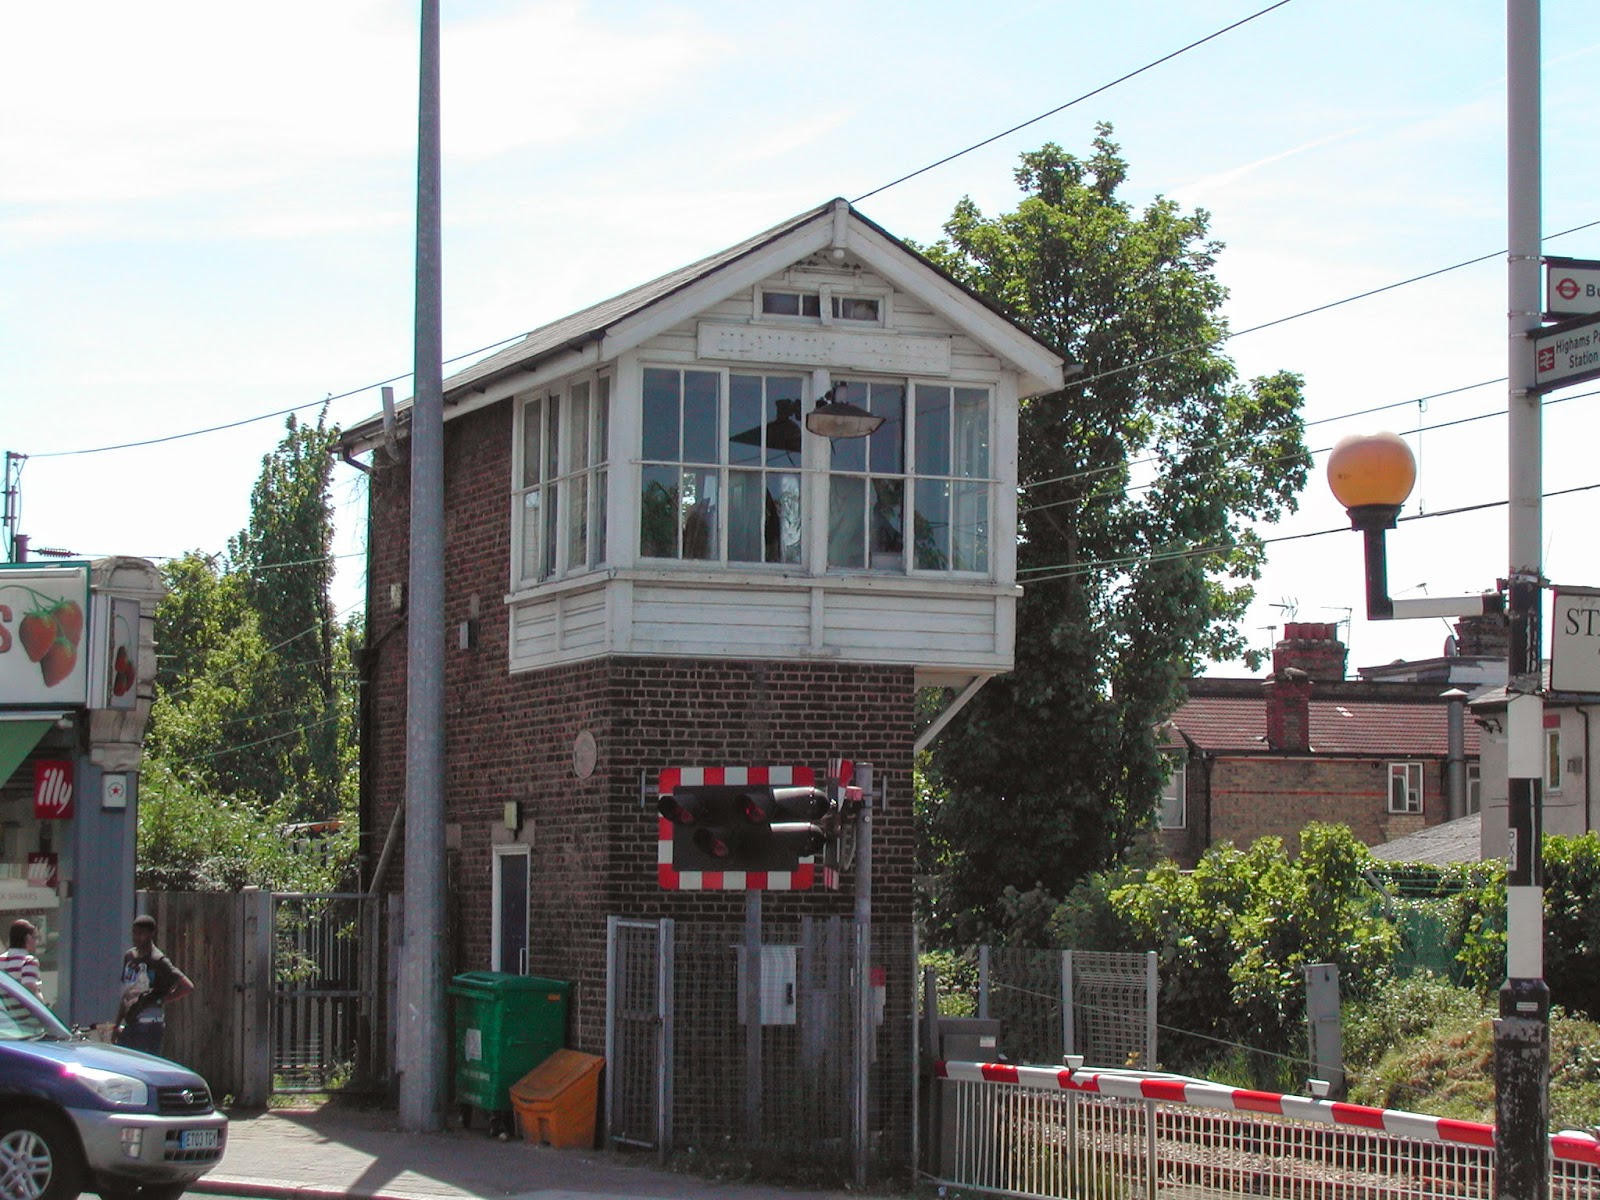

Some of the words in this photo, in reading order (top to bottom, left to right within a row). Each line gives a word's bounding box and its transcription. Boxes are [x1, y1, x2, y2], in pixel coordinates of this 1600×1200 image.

[1556, 335, 1590, 354] Highams
[1593, 330, 1600, 344] P
[1569, 351, 1598, 369] Station
[1565, 607, 1600, 637] ST
[38, 767, 73, 815] illy
